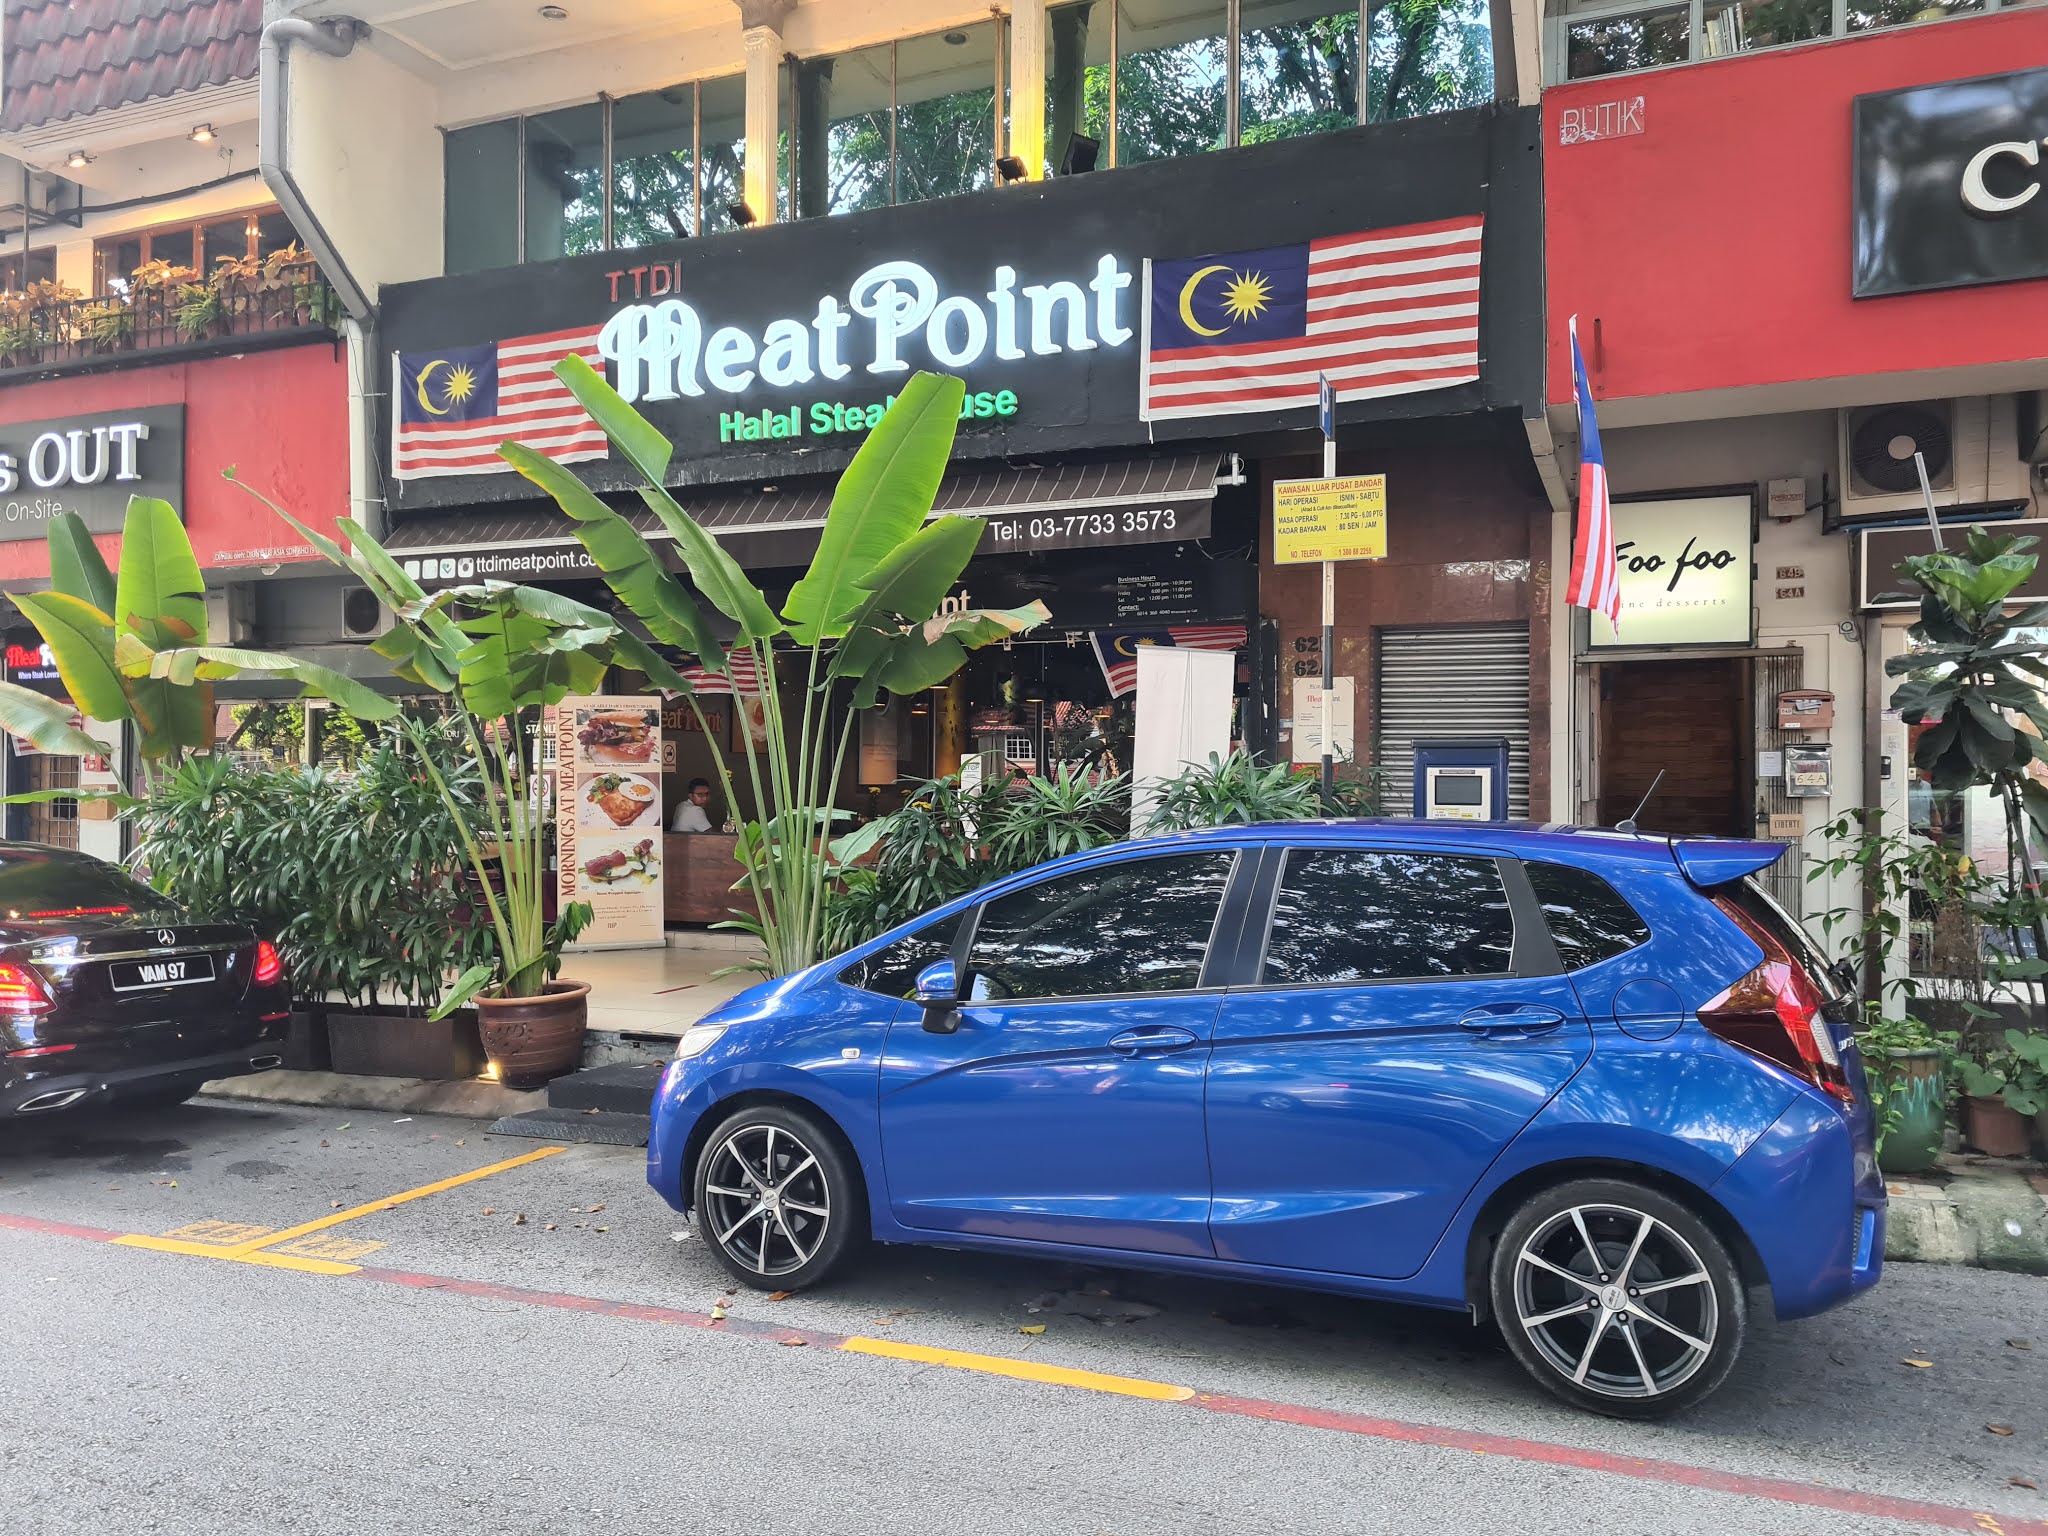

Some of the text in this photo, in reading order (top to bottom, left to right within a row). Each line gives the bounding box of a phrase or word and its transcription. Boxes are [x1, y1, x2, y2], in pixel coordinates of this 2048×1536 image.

[1563, 98, 1642, 143] BUTIK
[1961, 137, 2048, 217] C
[605, 258, 682, 303] TTDI
[597, 254, 1133, 403] Meat Point
[719, 405, 801, 443] Halal
[958, 388, 1018, 421] use
[28, 423, 150, 487] OUT
[1278, 478, 1383, 495] KAWASAN LUAR PUSAT BANDAR
[1278, 498, 1292, 506] HARI
[1293, 496, 1318, 505] OPERASI
[1339, 493, 1355, 502] ISNIN
[1360, 491, 1380, 500] SABTU
[6, 498, 62, 522] On-Site
[1278, 516, 1294, 524] MASA
[1294, 515, 1318, 523] OPERASI
[1372, 509, 1383, 517] PTG
[989, 509, 1176, 541] Tel: 03-7733 3573
[1278, 526, 1299, 535] KADAR
[1300, 525, 1326, 534] BAYARAN
[1339, 523, 1346, 531] 80
[1347, 522, 1360, 530] SEN
[476, 551, 597, 573] ttdimeatpoint.co
[1301, 549, 1322, 558] TELEFON
[1615, 536, 1737, 592] Foo foo
[1621, 598, 1727, 609] ine desserts
[6, 644, 41, 667] Meat
[1294, 659, 1323, 676] 62
[525, 724, 556, 734] STANLE
[661, 710, 680, 730] eat
[1796, 773, 1826, 784] 64A
[558, 707, 576, 897] MORNINGS AT MEATPOINT
[138, 962, 186, 983] VAM 97
